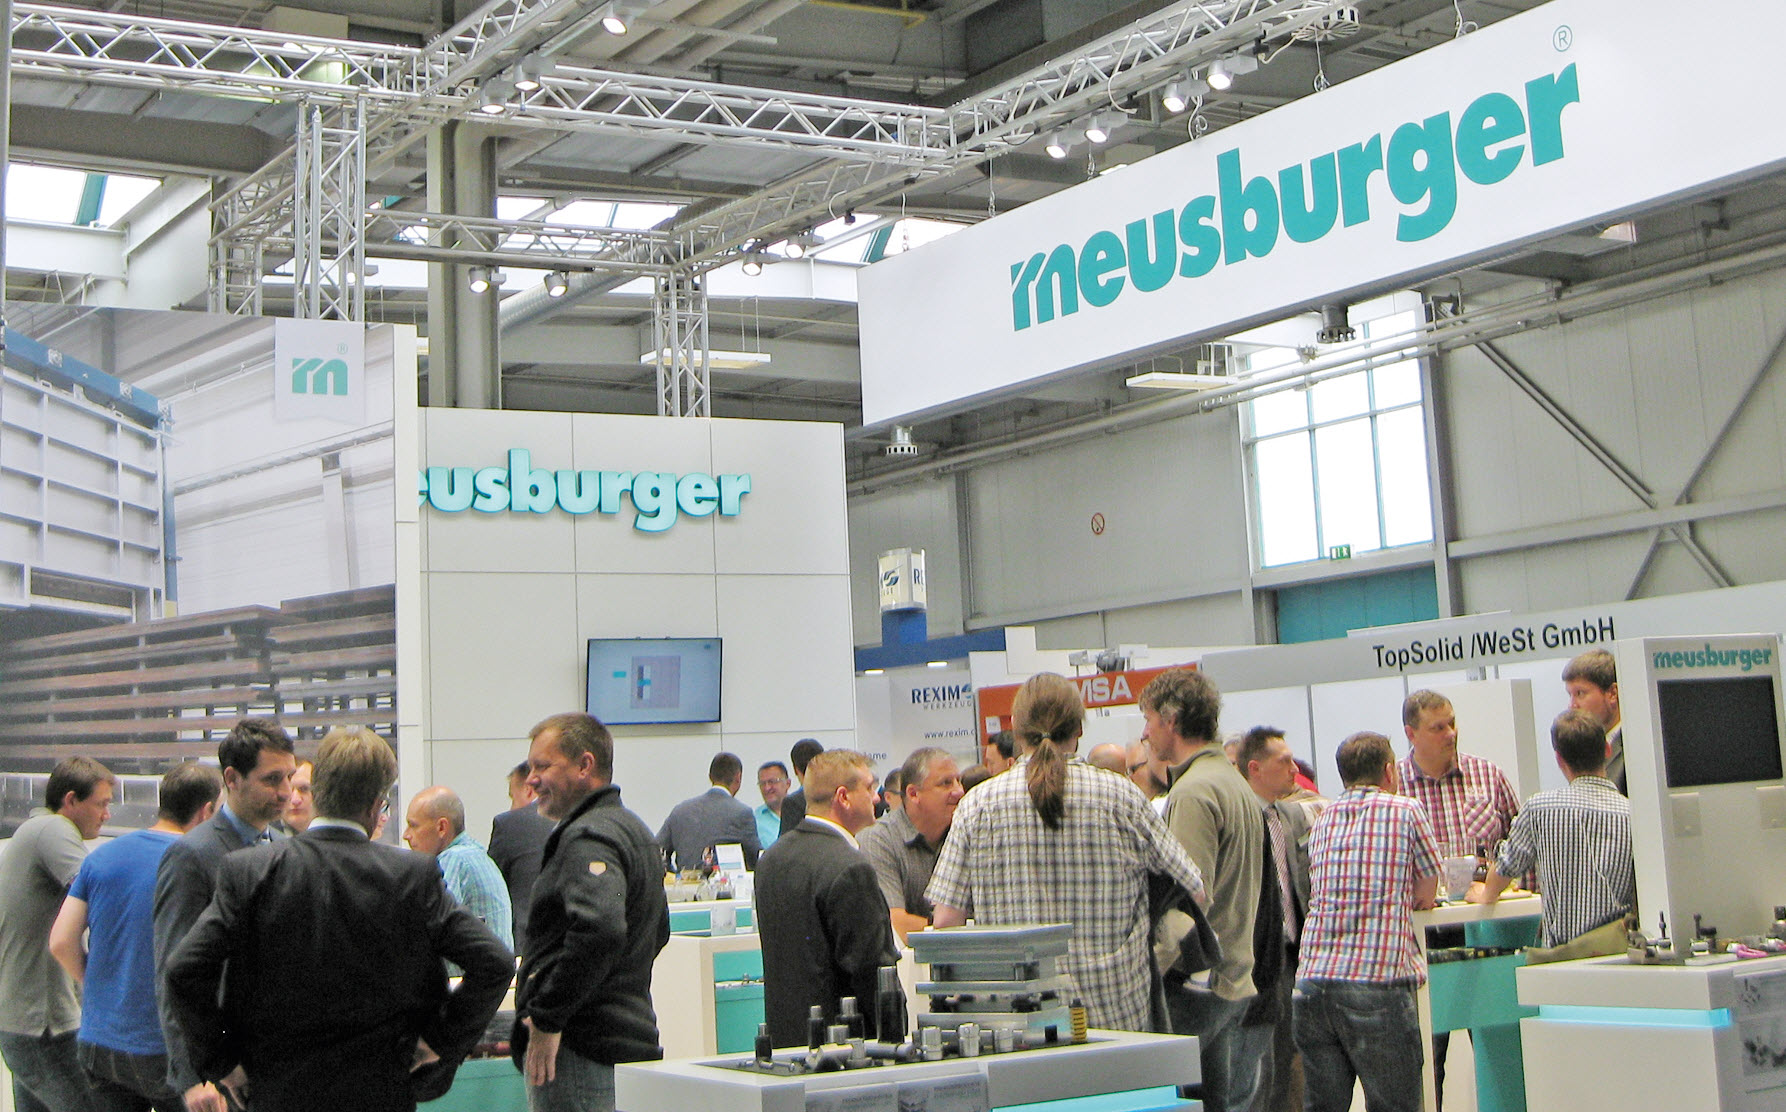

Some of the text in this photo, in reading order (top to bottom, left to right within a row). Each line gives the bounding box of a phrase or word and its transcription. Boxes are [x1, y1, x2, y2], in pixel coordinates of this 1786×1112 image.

[1010, 62, 1580, 332] meusburger
[418, 447, 752, 533] usburger
[1372, 616, 1616, 672] TopSolid /WeSt GmbH
[1652, 642, 1772, 672] meusburger
[911, 684, 960, 705] REXIM
